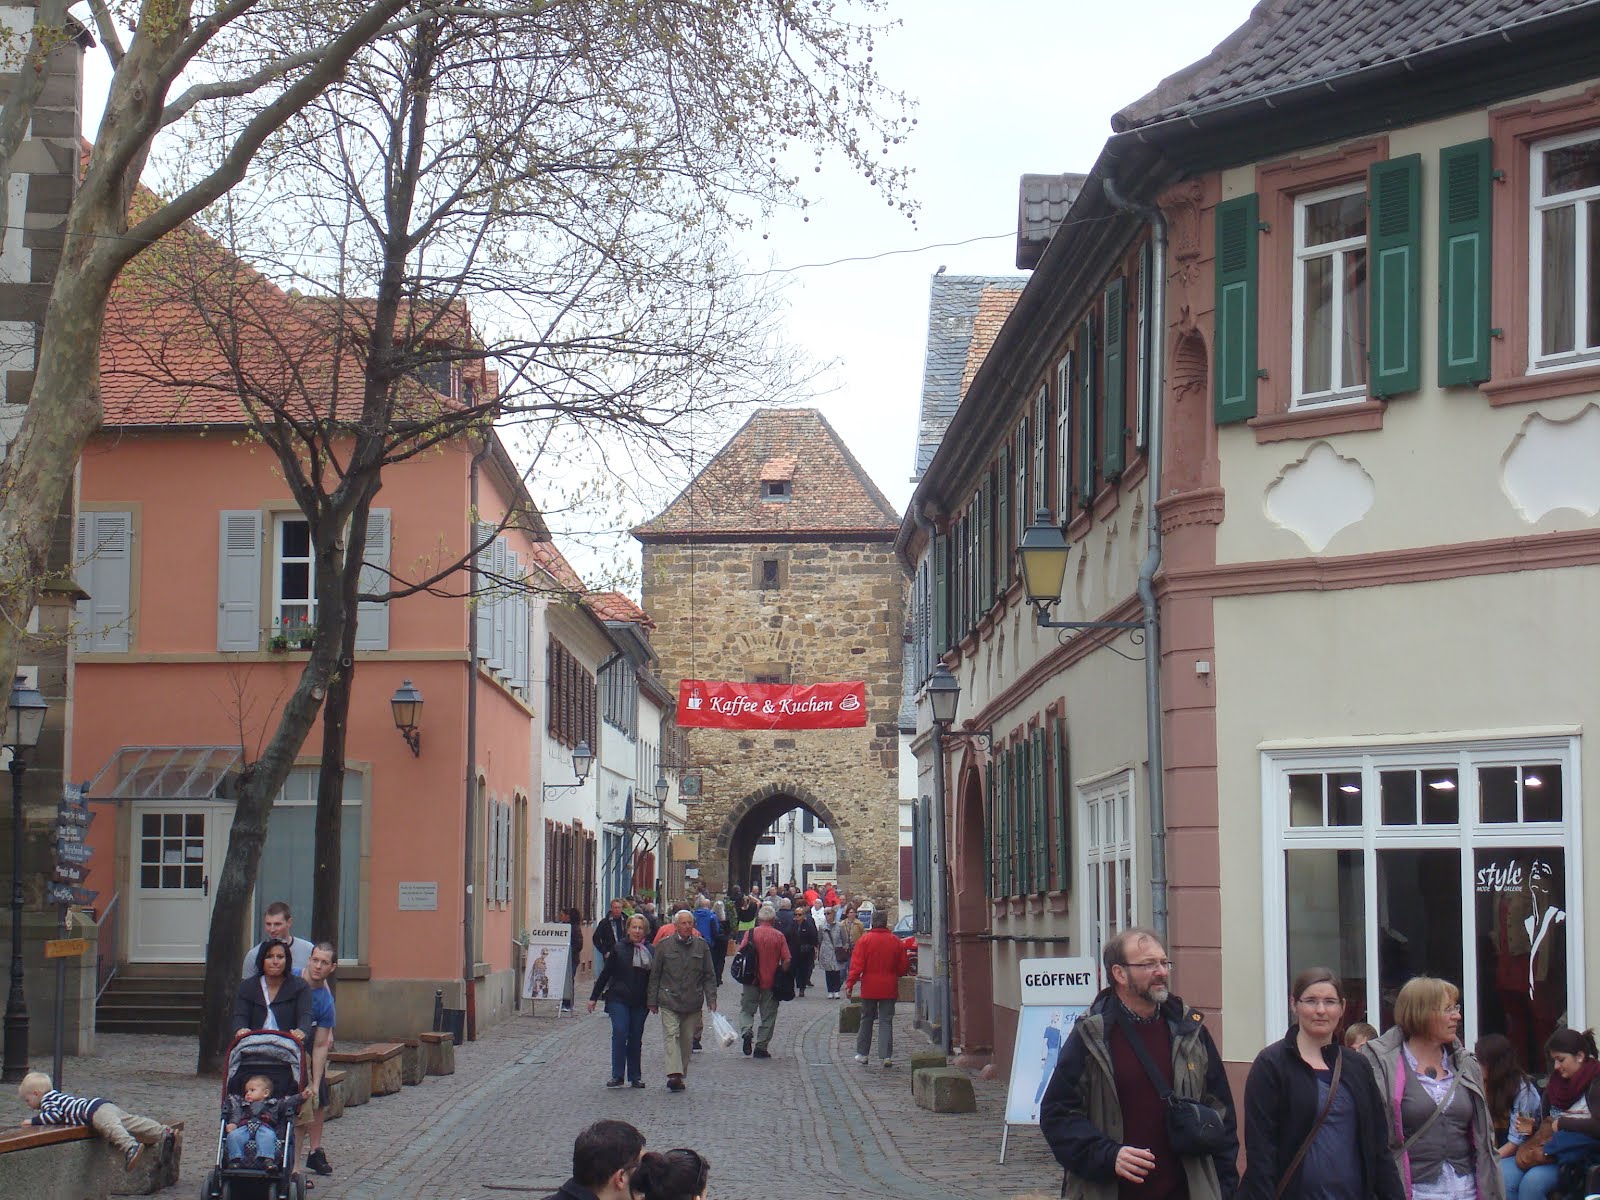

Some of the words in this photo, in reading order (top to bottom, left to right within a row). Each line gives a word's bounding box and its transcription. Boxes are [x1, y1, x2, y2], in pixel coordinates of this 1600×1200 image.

[709, 696, 758, 716] Kaffee
[762, 700, 775, 714] &
[779, 696, 833, 715] Kuchen
[1476, 860, 1523, 892] style
[1025, 971, 1091, 986] GEÖFFNET
